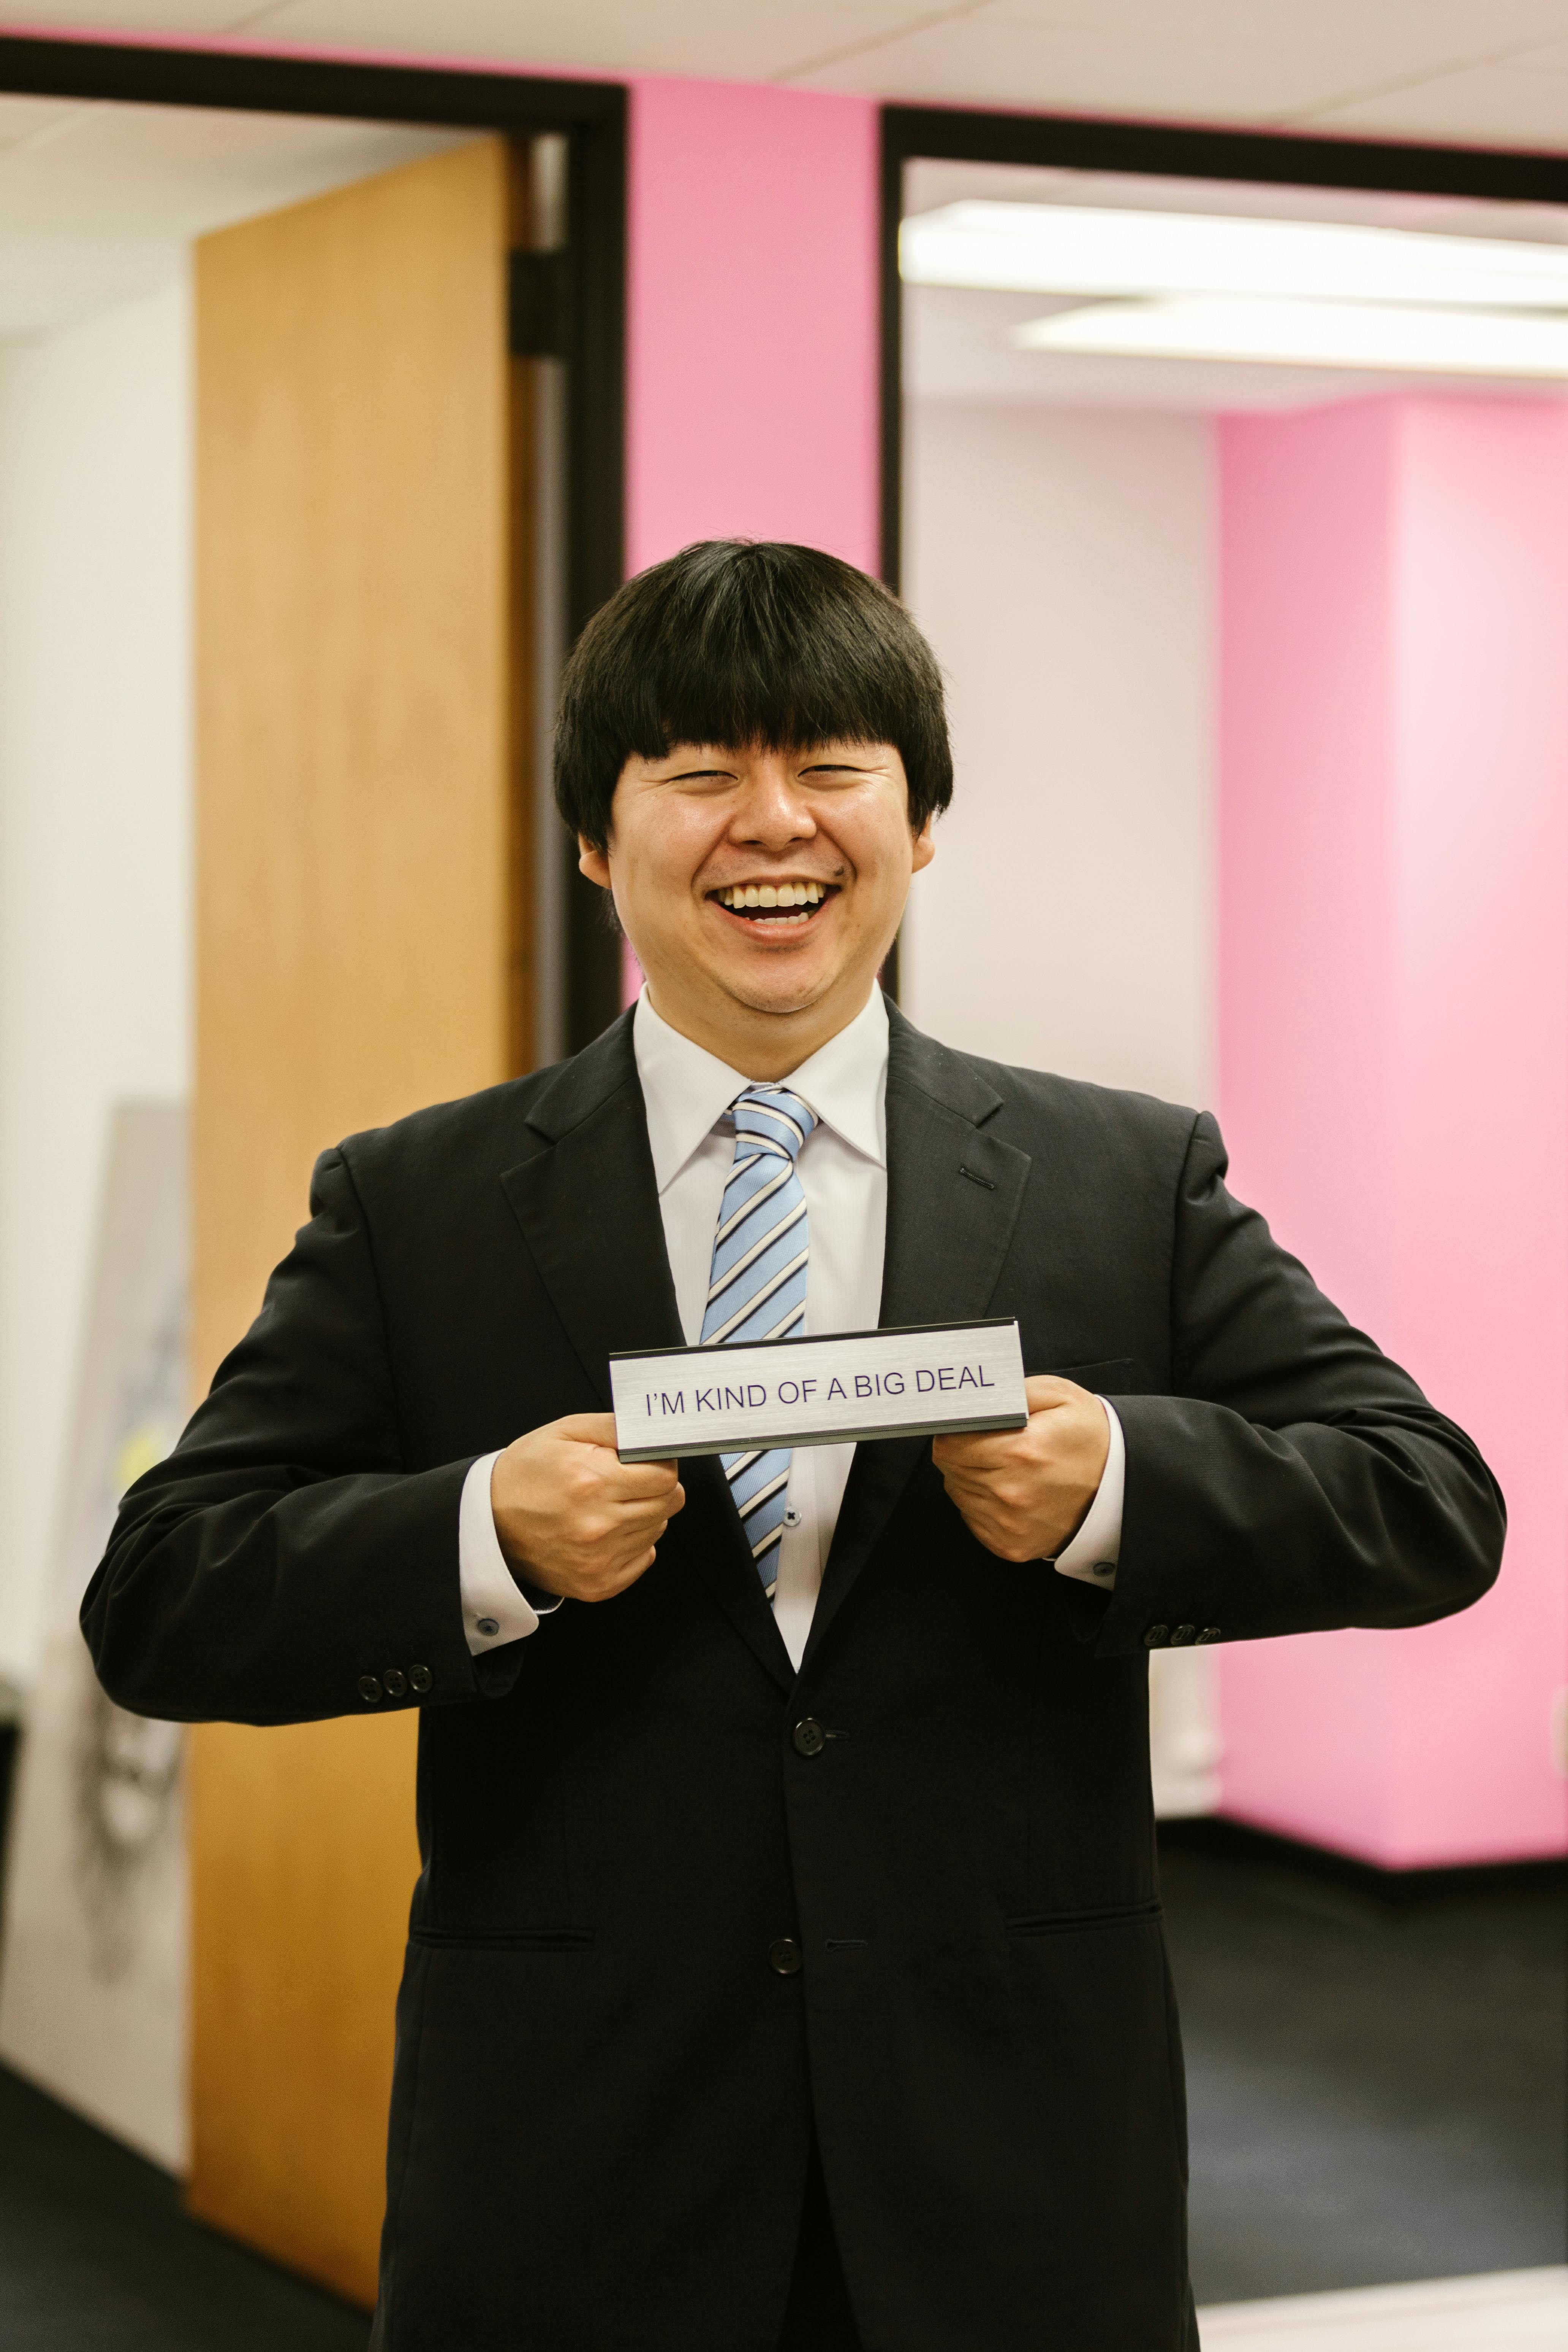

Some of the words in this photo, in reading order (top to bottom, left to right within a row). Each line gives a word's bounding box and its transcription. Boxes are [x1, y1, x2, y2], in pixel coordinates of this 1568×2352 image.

[646, 1391, 685, 1417] I'M
[695, 1384, 767, 1412] KIND
[778, 1379, 817, 1404] OF
[827, 1377, 848, 1401] A
[854, 1372, 905, 1398] BIG
[915, 1364, 995, 1393] DEAL
